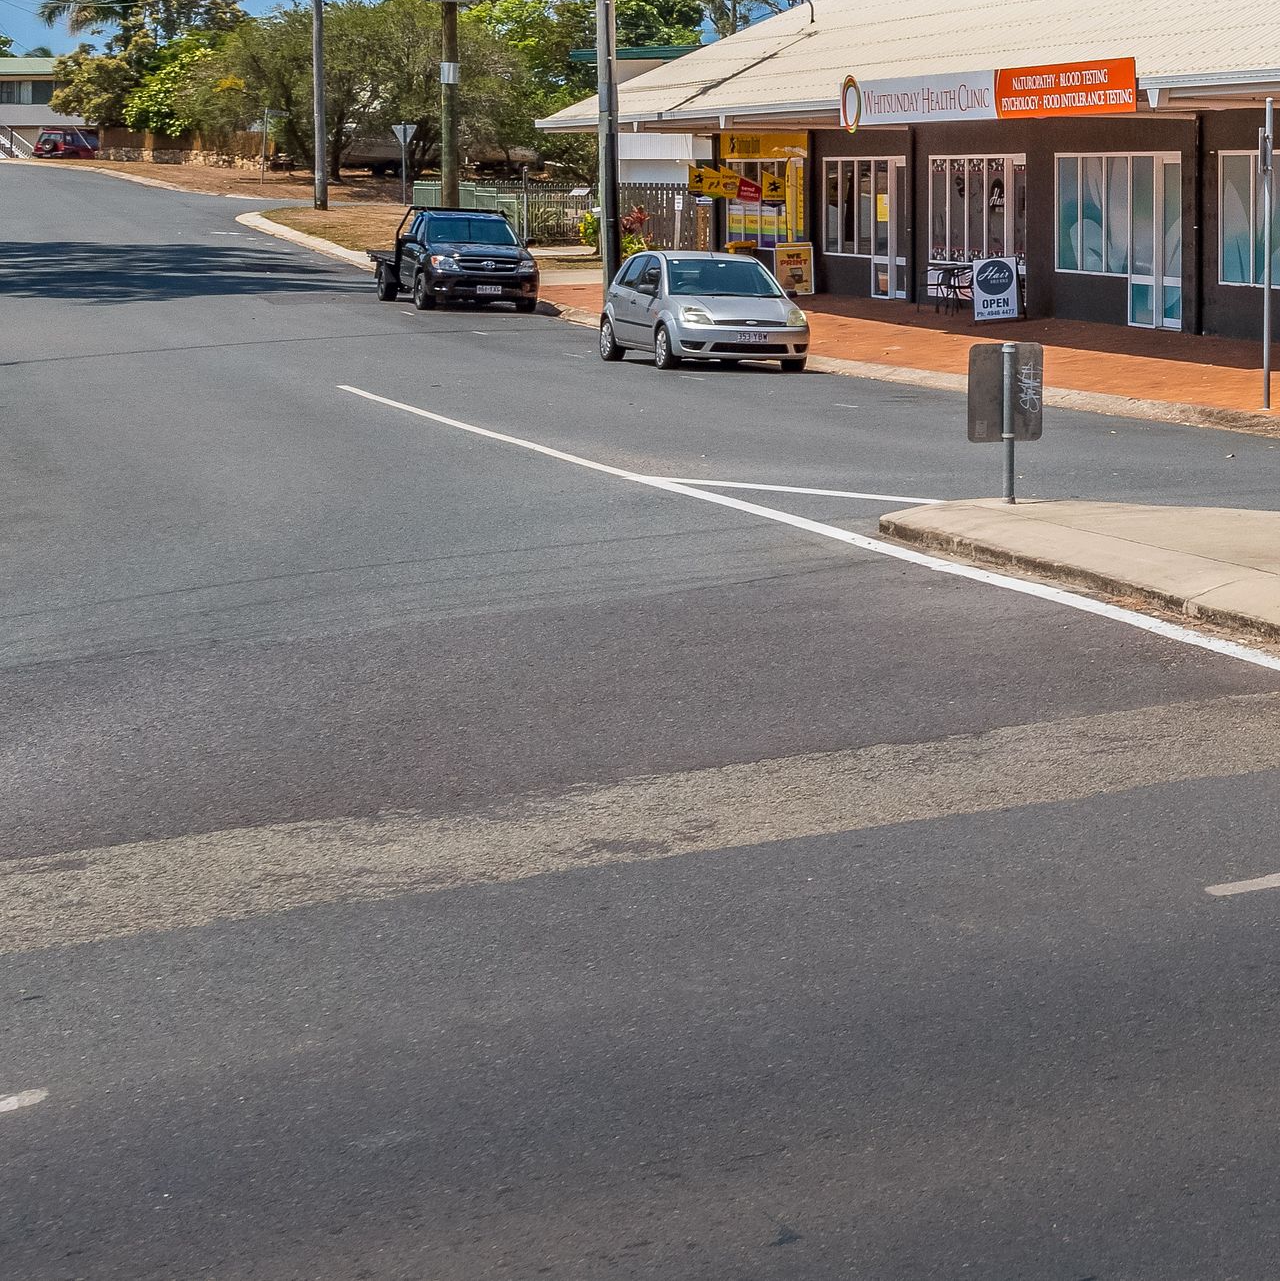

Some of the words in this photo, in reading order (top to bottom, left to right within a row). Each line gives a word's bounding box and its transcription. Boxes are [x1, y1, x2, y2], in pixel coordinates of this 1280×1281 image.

[1012, 74, 1056, 90] NATUROPATHY
[1060, 71, 1081, 87] BLOOD
[1082, 68, 1108, 84] TESTING
[1001, 95, 1039, 111] PSYCHOLOGY
[1043, 94, 1060, 109] FOOD
[1061, 89, 1104, 108] INTOLERANCE
[1105, 88, 1133, 105] TESTING
[989, 187, 1004, 207] Hai
[780, 258, 808, 266] PRINT
[978, 266, 1009, 281] Hair
[982, 297, 1010, 309] OPEN
